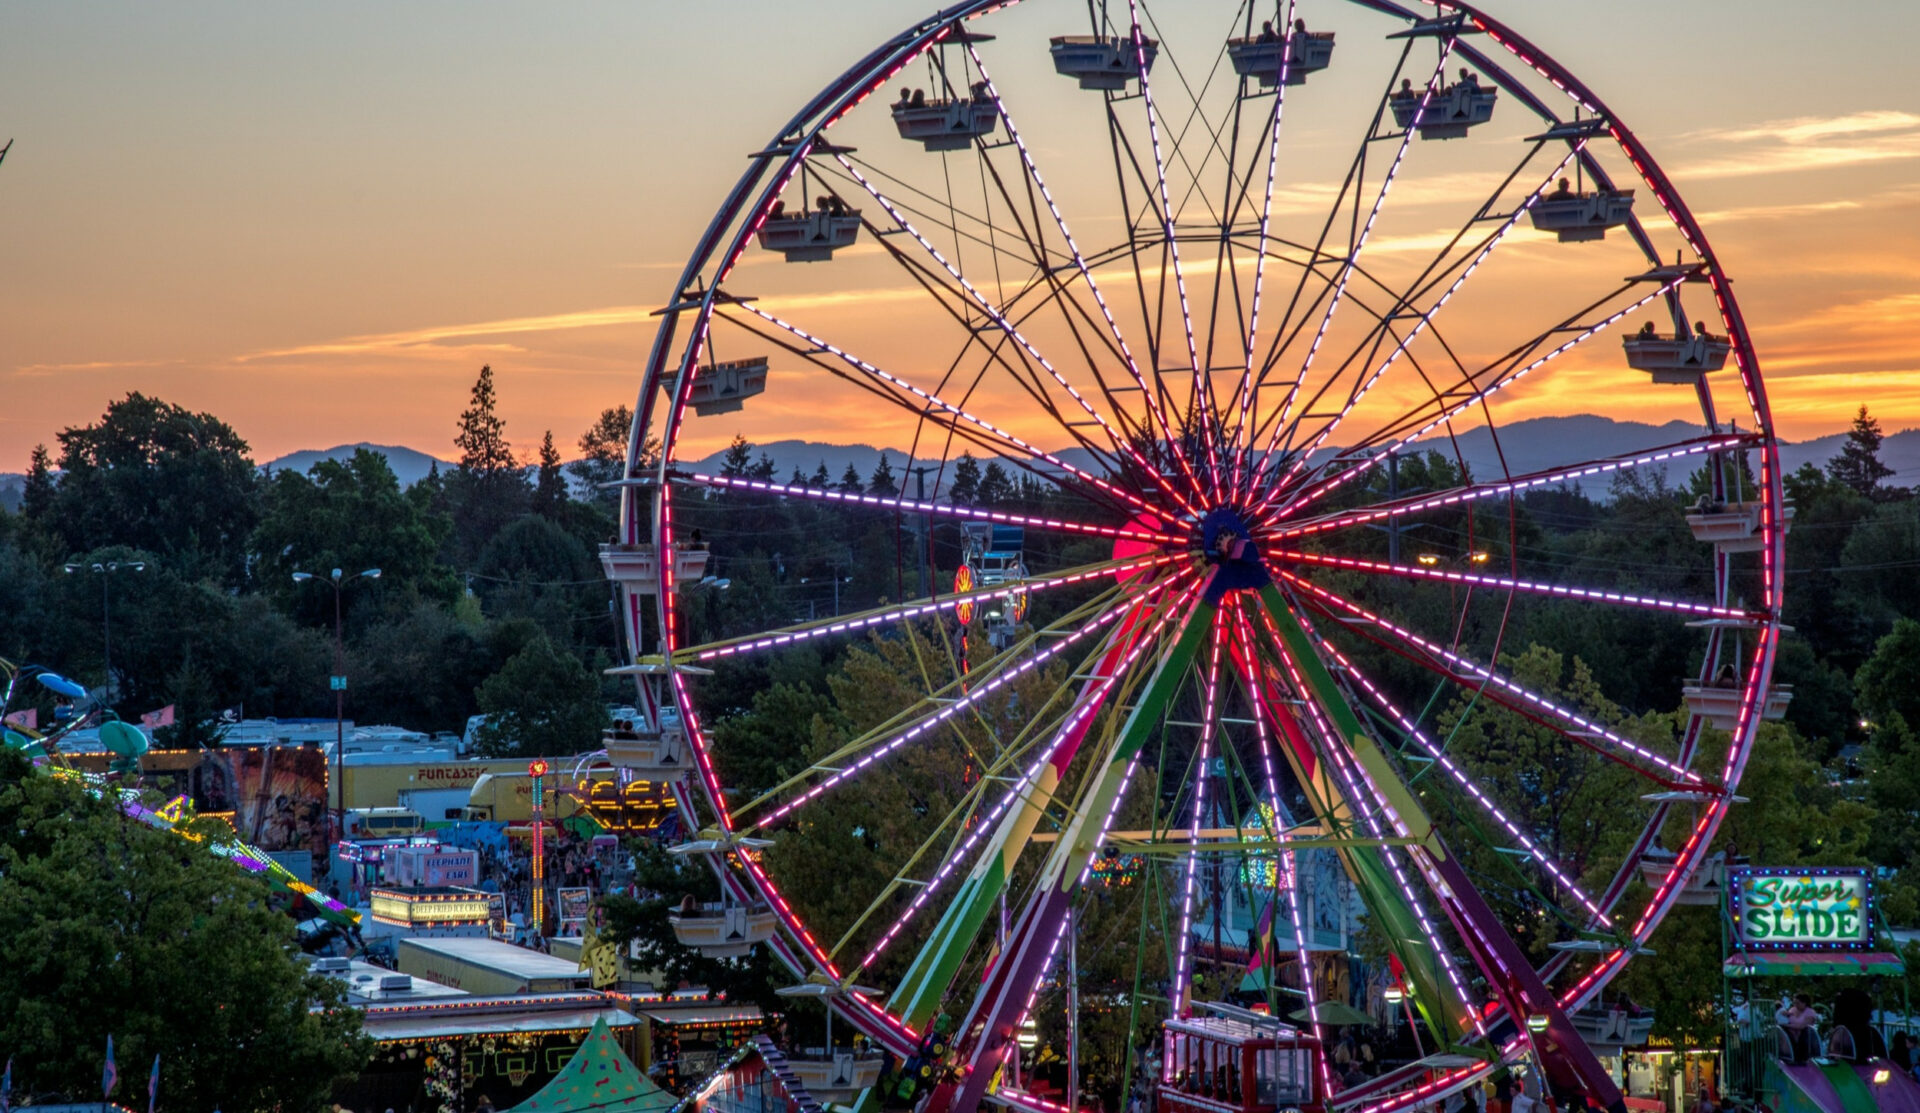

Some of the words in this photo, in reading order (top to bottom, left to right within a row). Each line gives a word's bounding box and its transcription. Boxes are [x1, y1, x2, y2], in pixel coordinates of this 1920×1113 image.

[426, 857, 470, 866] ELEPHANT
[1746, 878, 1853, 909] Super
[416, 902, 432, 913] DEEP
[433, 902, 453, 912] FRIED
[465, 901, 487, 911] CREAM
[1746, 908, 1860, 938] SLIDE
[1648, 1034, 1675, 1046] Bac
